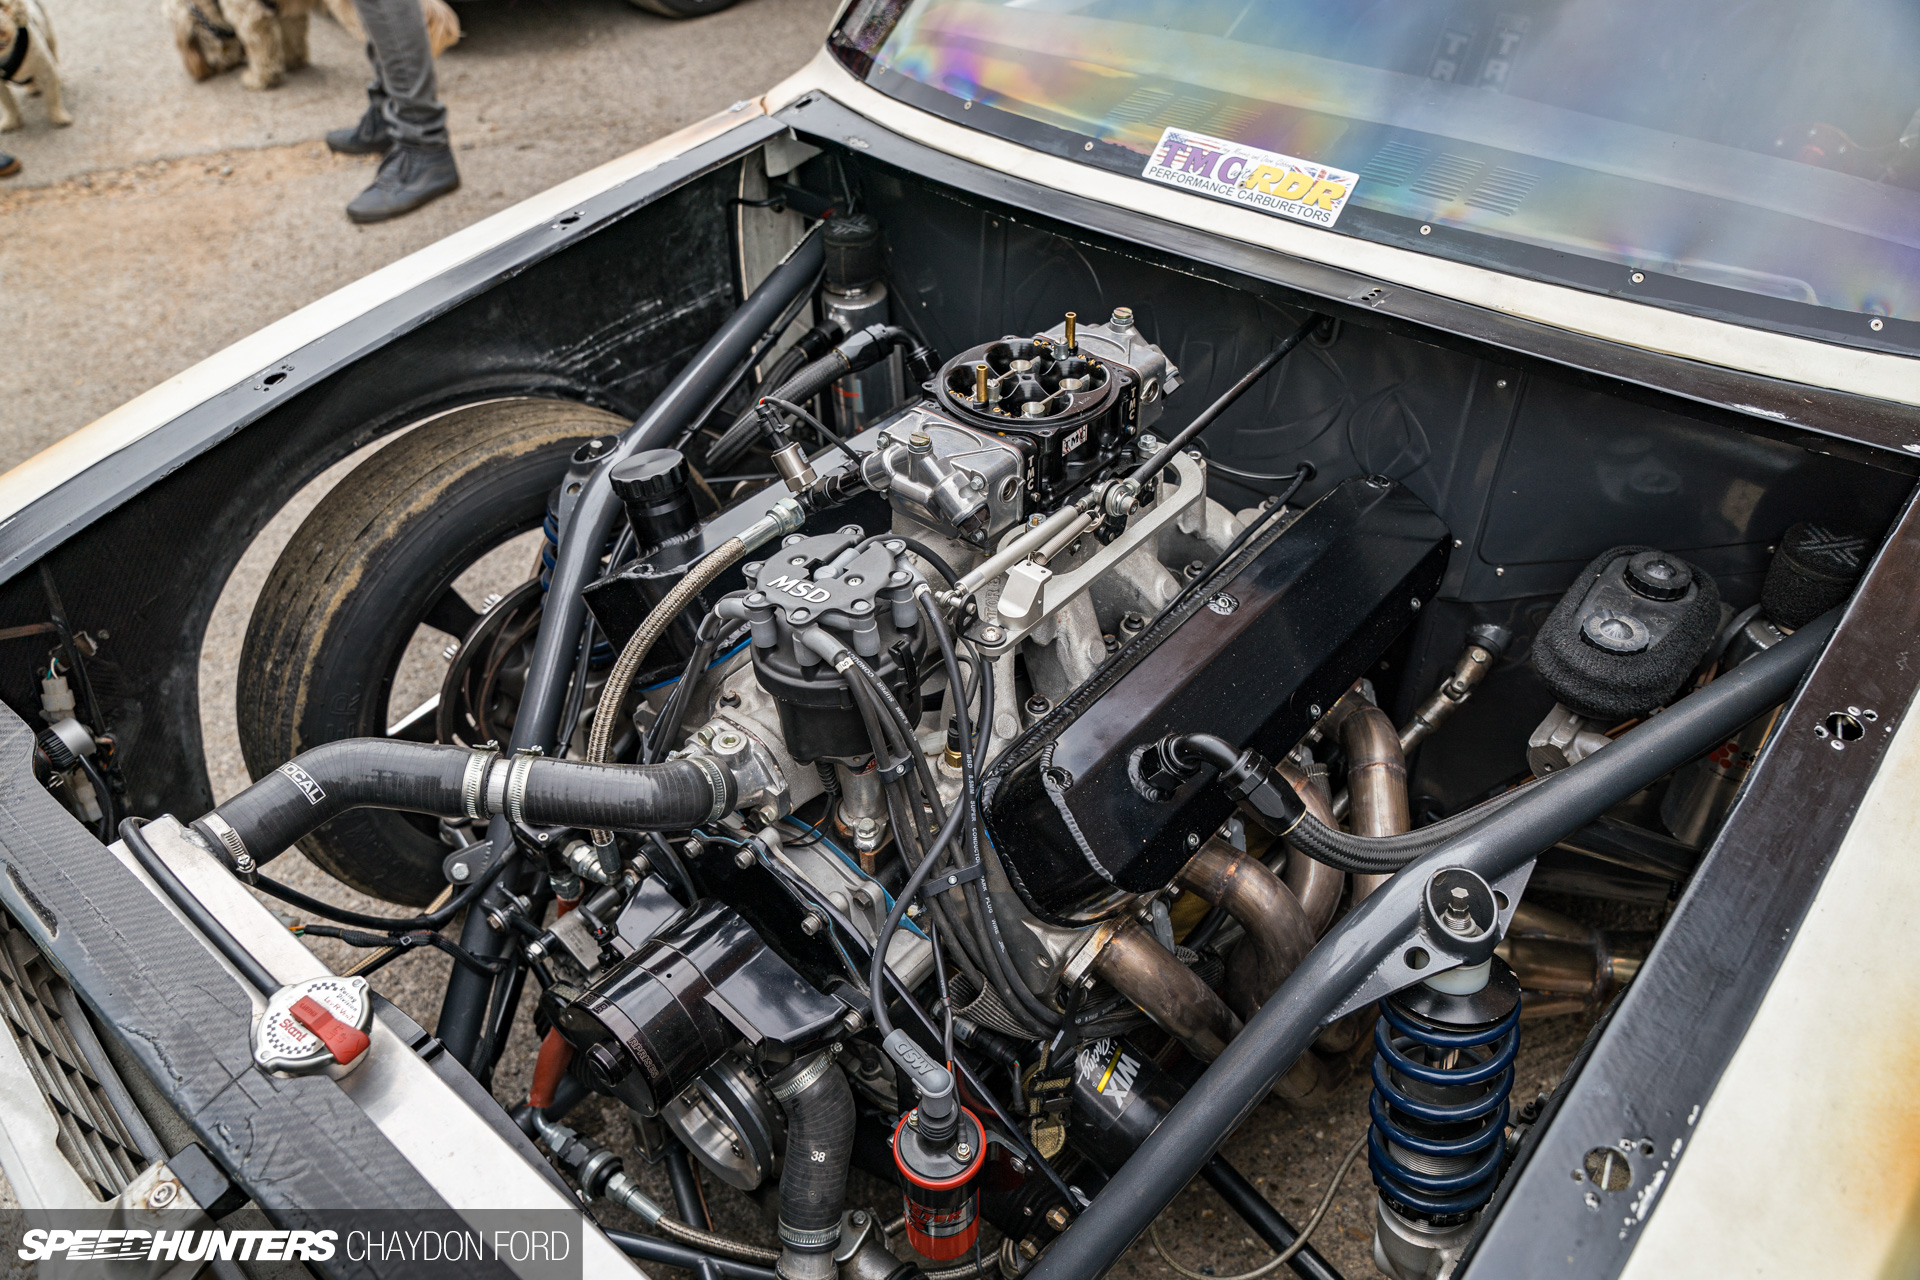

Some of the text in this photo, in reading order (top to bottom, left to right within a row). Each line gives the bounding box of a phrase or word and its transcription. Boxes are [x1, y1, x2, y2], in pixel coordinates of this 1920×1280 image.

[1158, 139, 1247, 186] TMC
[1245, 163, 1346, 211] RDR
[1148, 166, 1331, 223] PERFORMANCE CARBURETORS
[1128, 386, 1137, 421] TMC
[1026, 454, 1035, 491] TMC
[766, 575, 831, 603] MSD
[846, 649, 874, 678] CONDUCT
[876, 682, 894, 703] SUPER
[972, 827, 981, 864] CONDUCTO
[985, 897, 993, 914] PLUG
[278, 1018, 308, 1042] Stant
[894, 1043, 934, 1076] MSD
[1102, 1052, 1141, 1109] WIX
[810, 1150, 826, 1163] 38
